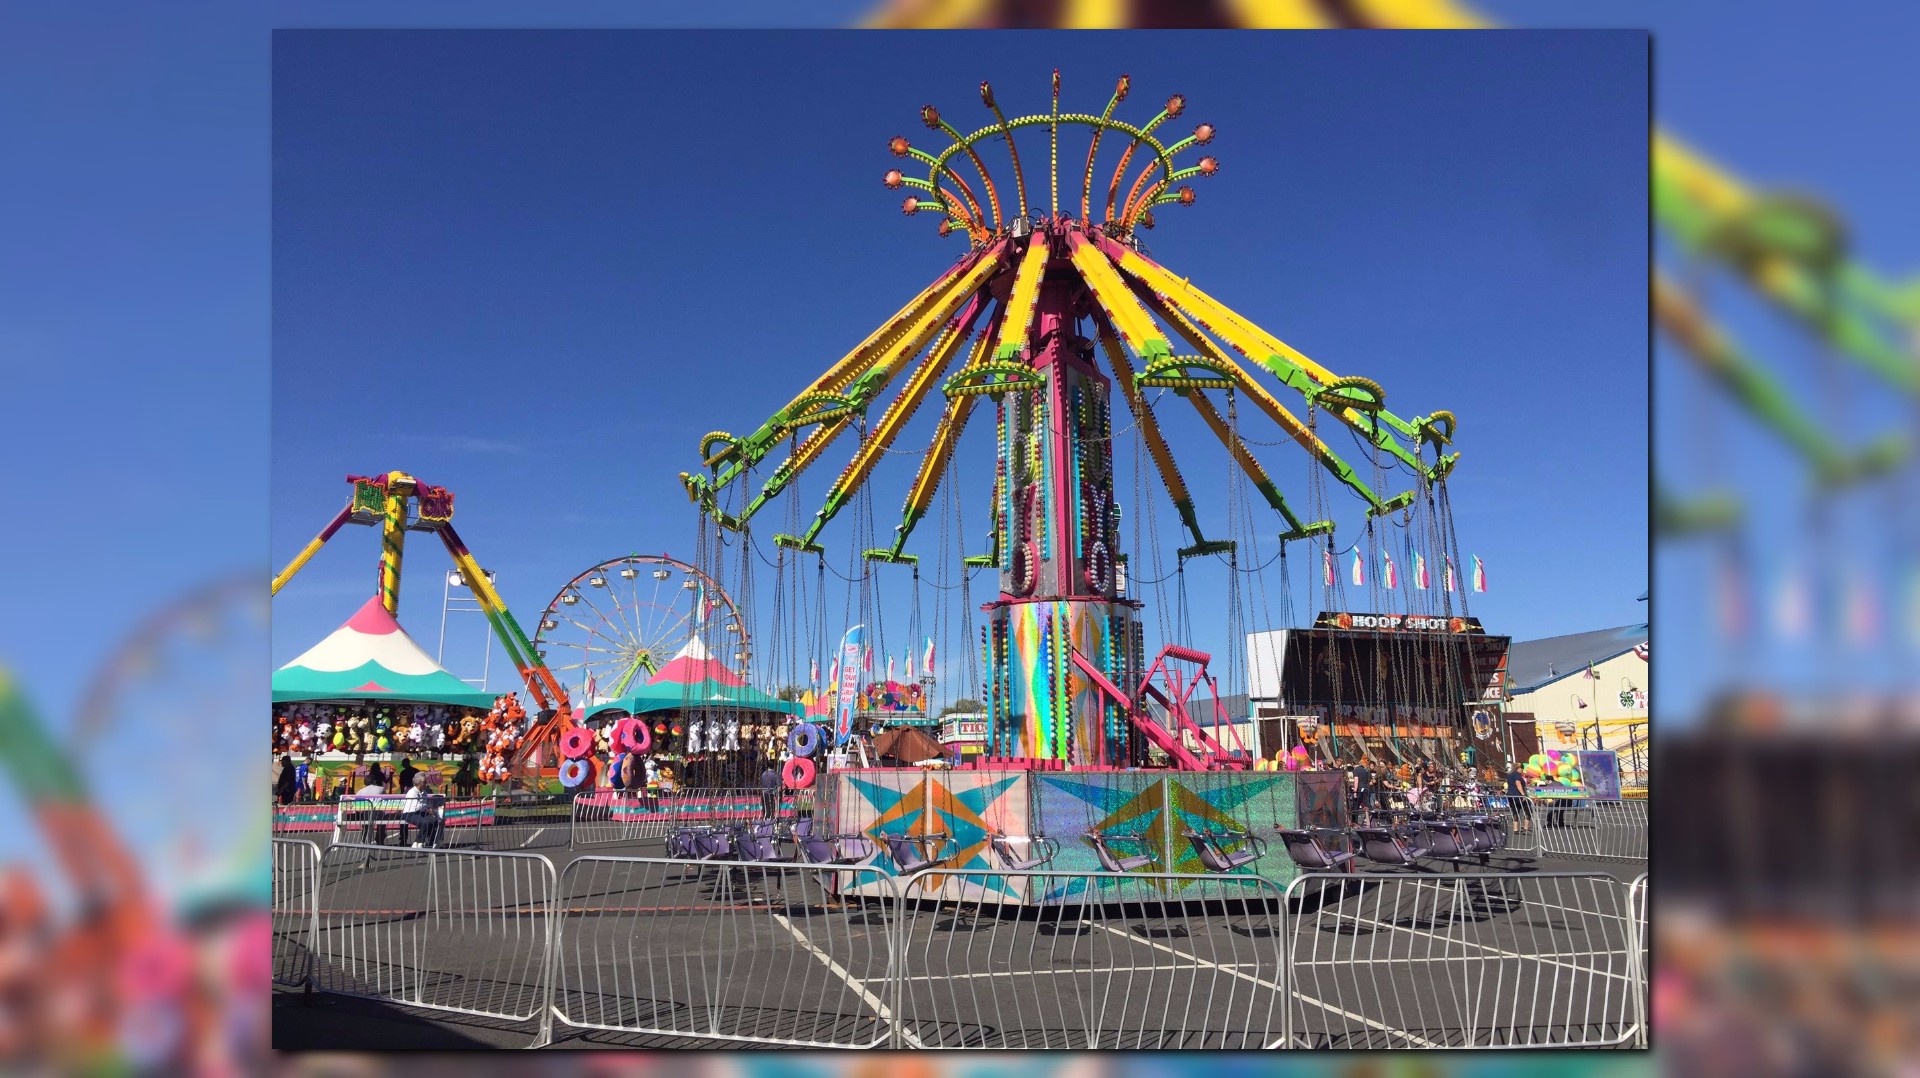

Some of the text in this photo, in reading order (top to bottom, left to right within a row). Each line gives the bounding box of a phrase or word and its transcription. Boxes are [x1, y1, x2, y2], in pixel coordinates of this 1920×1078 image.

[1351, 615, 1448, 630] HOOP SHOT
[1462, 641, 1506, 652] HOP SHOT
